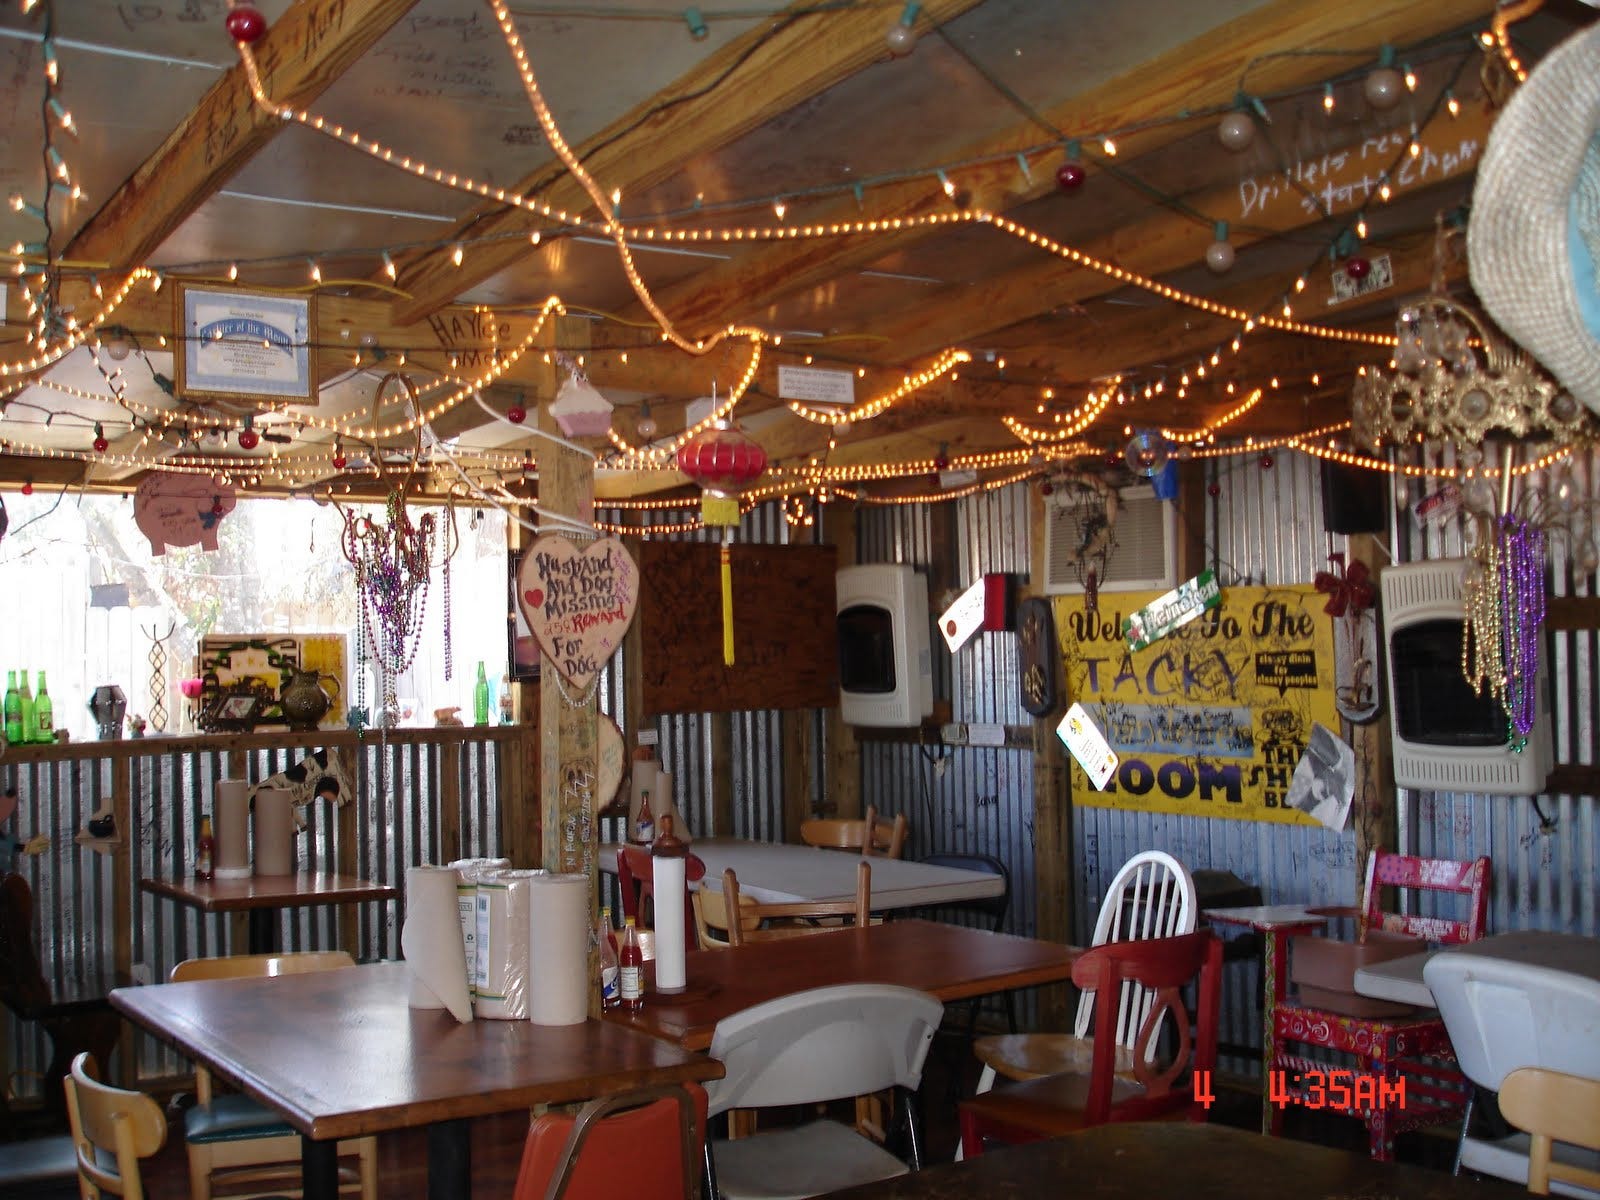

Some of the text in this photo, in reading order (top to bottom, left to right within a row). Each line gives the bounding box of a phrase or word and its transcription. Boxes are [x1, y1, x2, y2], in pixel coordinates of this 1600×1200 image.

[1069, 610, 1192, 642] Wele
[1251, 600, 1315, 640] The
[552, 636, 583, 658] For
[1080, 650, 1250, 699] TACKY
